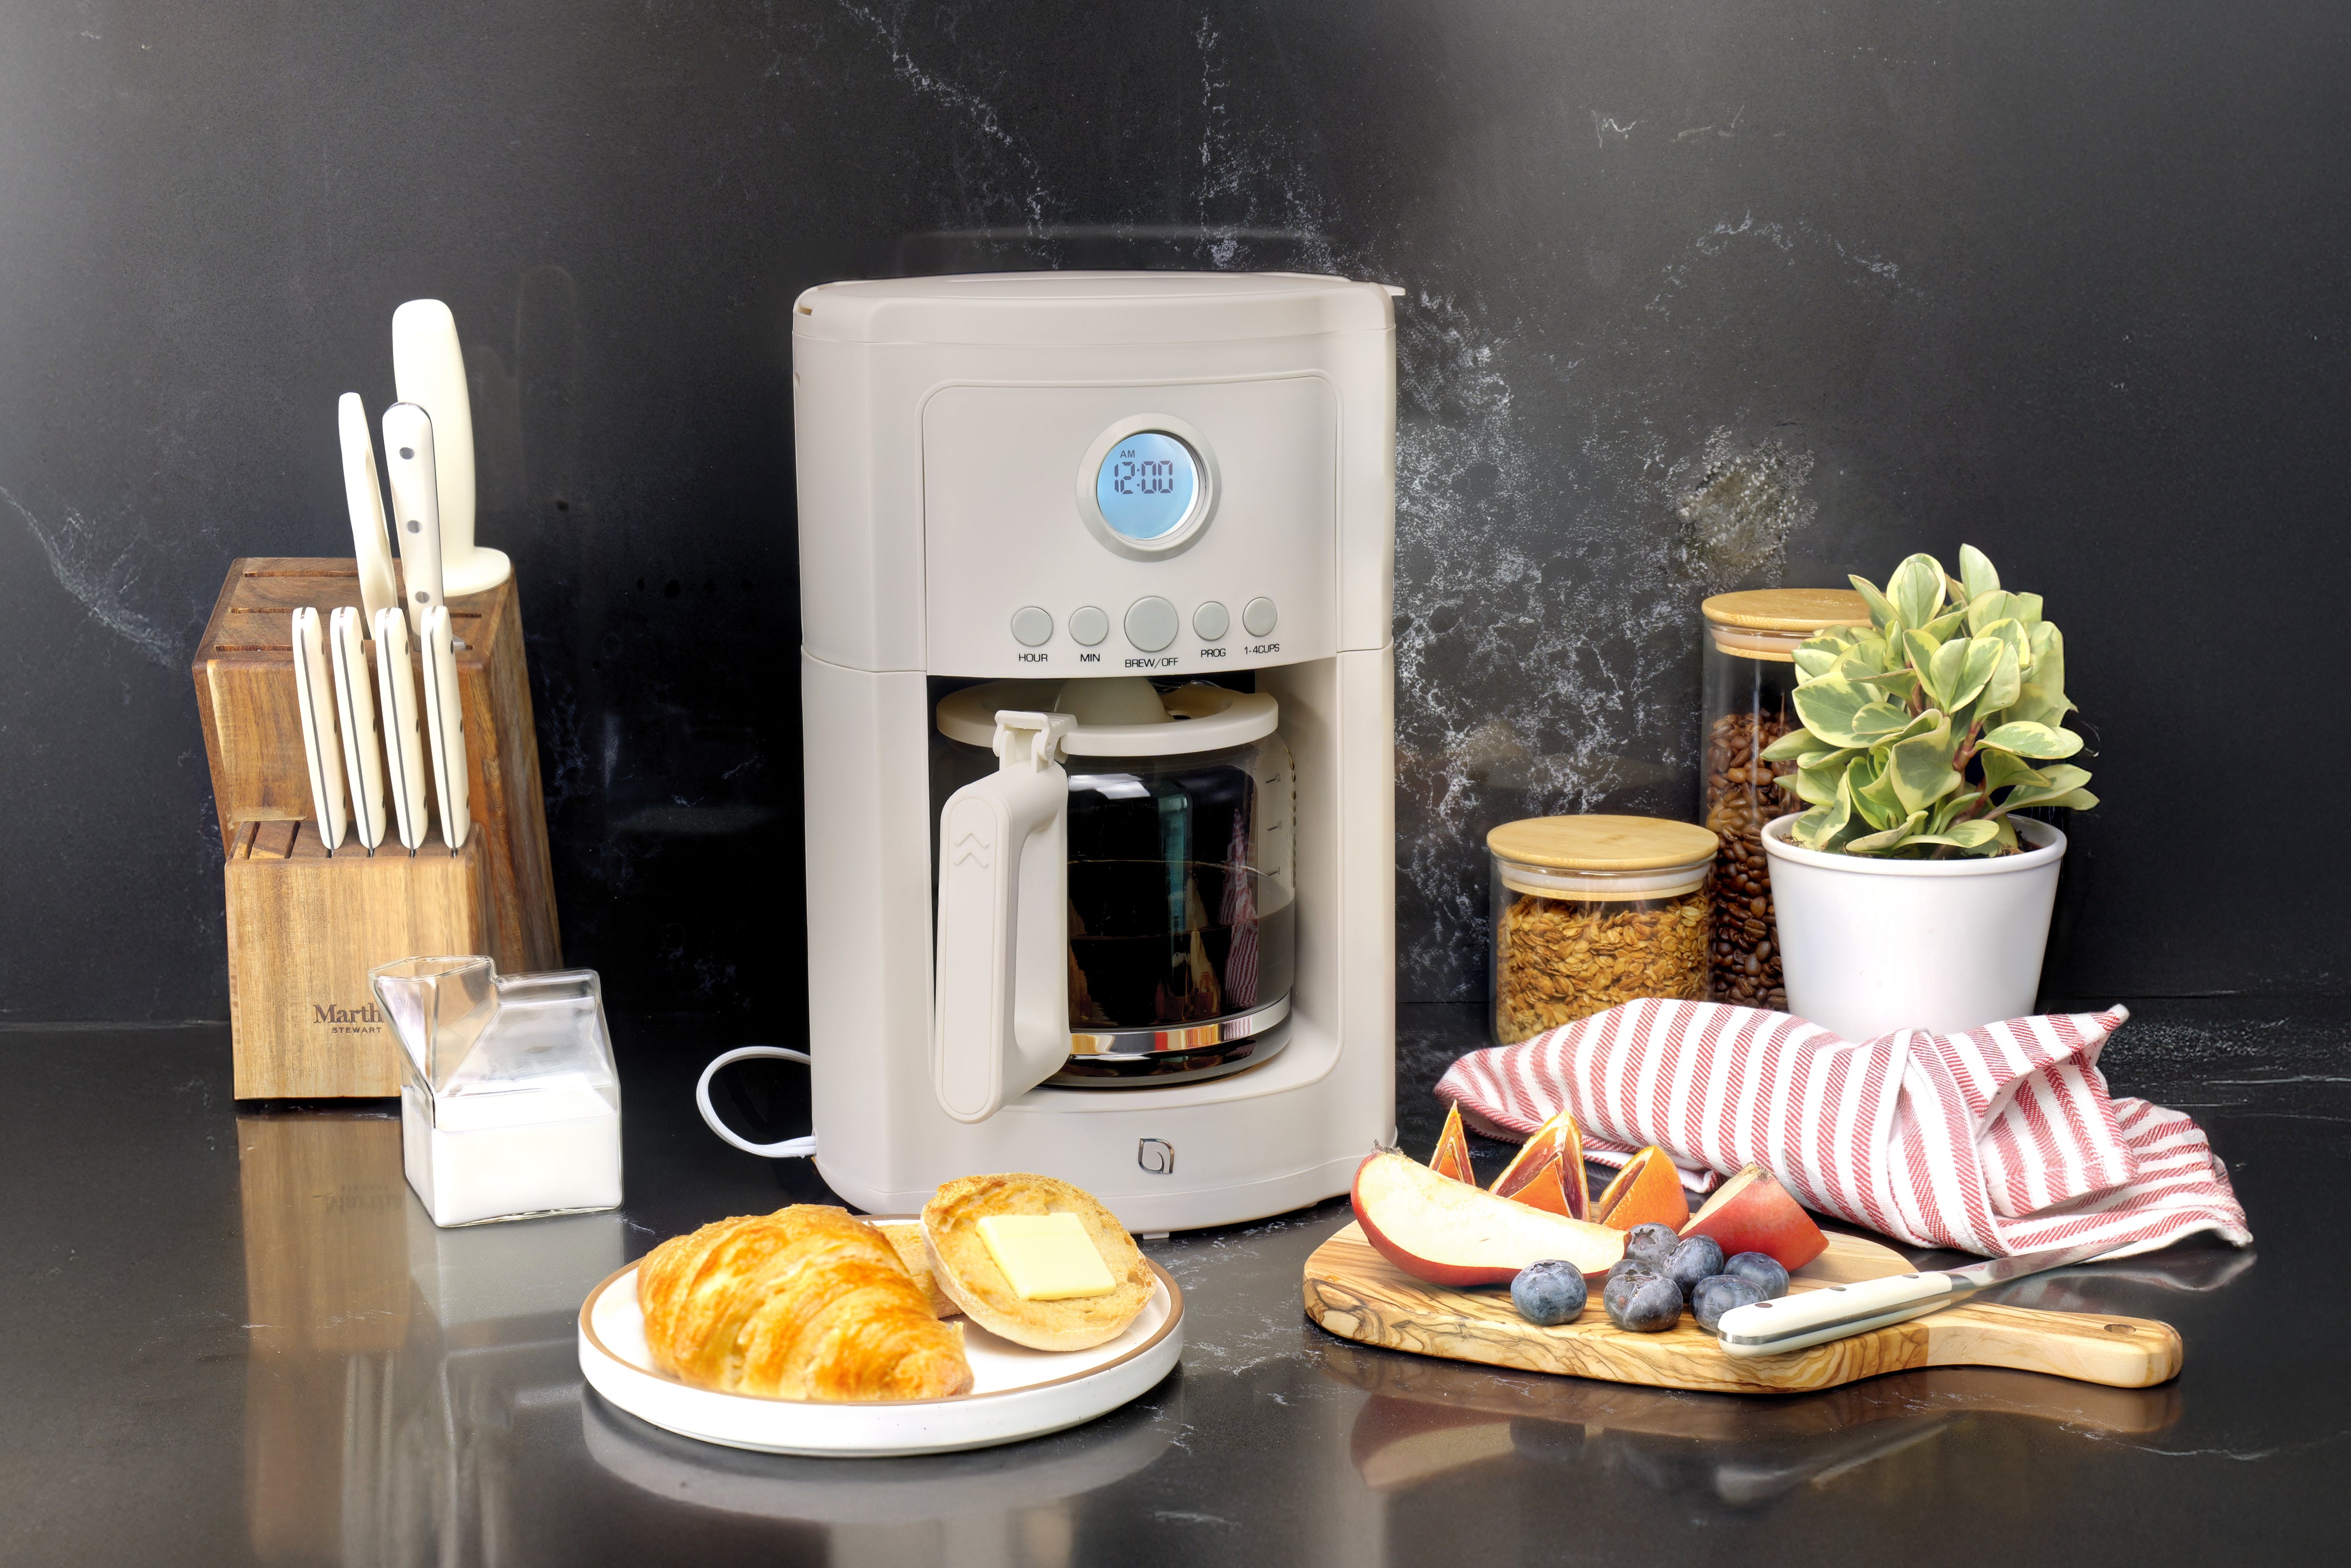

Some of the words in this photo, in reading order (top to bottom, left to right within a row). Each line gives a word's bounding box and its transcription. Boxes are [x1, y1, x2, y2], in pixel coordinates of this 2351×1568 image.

[1120, 450, 1136, 458] AM
[1114, 460, 1173, 495] 12:00
[1019, 653, 1048, 662] HOUR
[1080, 654, 1100, 662] MIN
[1201, 648, 1226, 658] PROG
[1125, 657, 1179, 669] BREW/OFF
[313, 1003, 384, 1024] Marth
